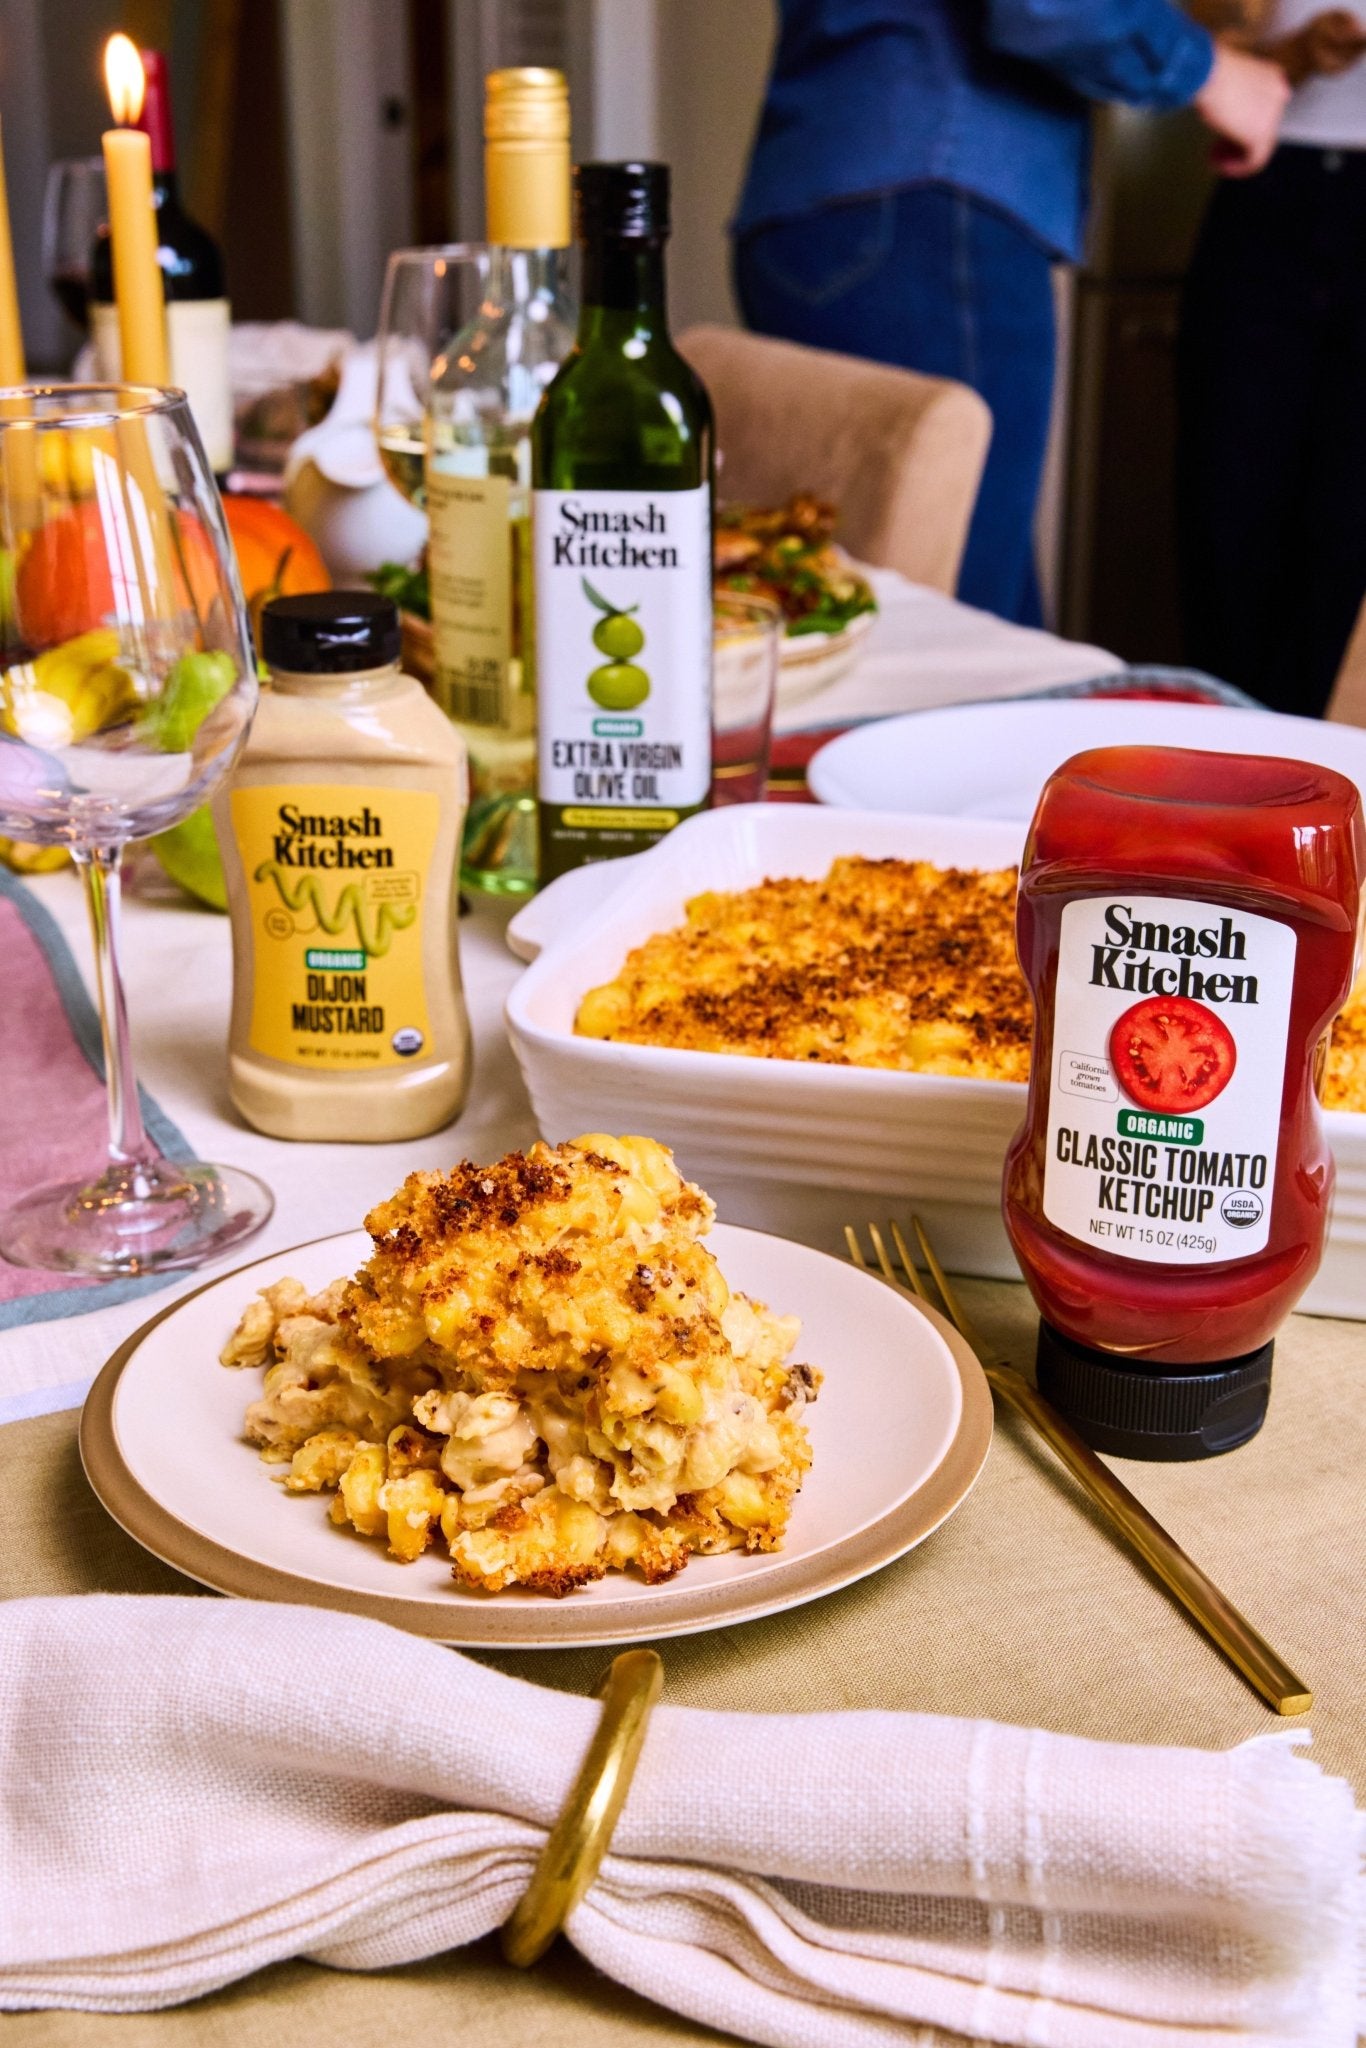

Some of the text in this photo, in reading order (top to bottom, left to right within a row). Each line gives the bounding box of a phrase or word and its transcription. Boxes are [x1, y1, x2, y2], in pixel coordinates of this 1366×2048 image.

[559, 500, 667, 535] Smash
[552, 534, 679, 569] Kitchen
[553, 741, 682, 769] EXTRA VIRGIN
[574, 773, 661, 800] OLIVE OIL
[278, 804, 382, 837] Smash
[273, 835, 394, 869] Kitchen
[1104, 904, 1246, 960] Smash
[307, 974, 366, 1002] DIJON
[1088, 944, 1259, 1004] Kitchen
[292, 1004, 384, 1034] MUSTARD
[1070, 1060, 1110, 1076] California
[1076, 1072, 1101, 1083] grown
[1070, 1079, 1107, 1092] tomatoes
[1127, 1115, 1194, 1140] ORGANIC
[1056, 1127, 1267, 1189] CLASSIC TOMATO
[1098, 1175, 1214, 1223] KETCHUP
[1231, 1199, 1254, 1209] USDA
[1226, 1210, 1257, 1219] ORGANIC
[1089, 1219, 1217, 1253] NET WT 15 OZ (425g)
